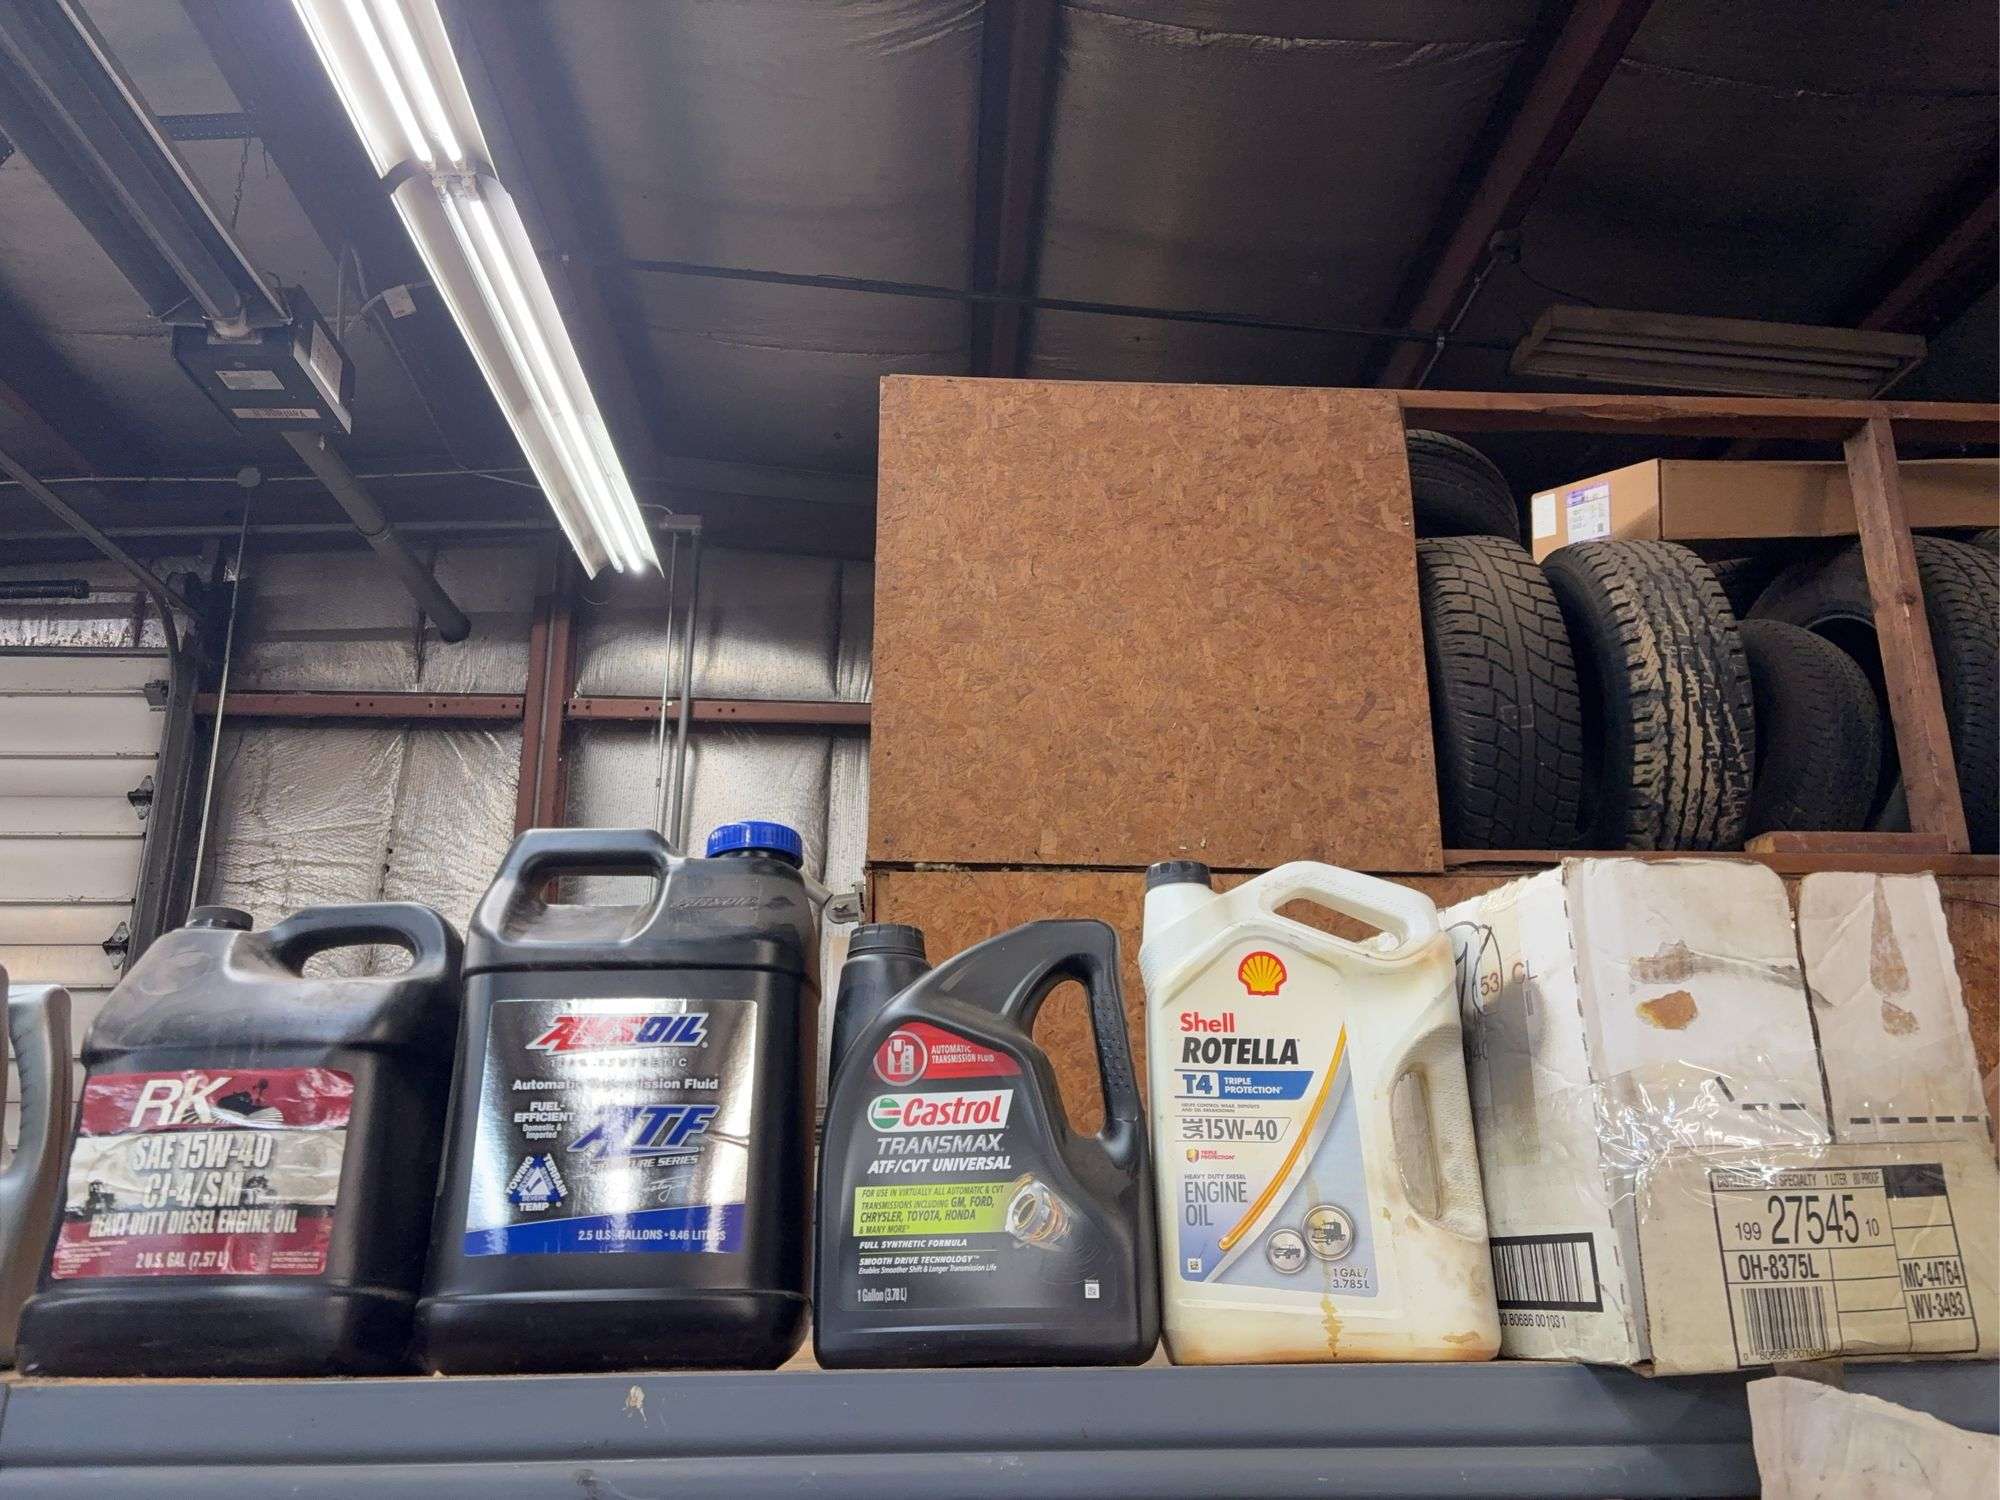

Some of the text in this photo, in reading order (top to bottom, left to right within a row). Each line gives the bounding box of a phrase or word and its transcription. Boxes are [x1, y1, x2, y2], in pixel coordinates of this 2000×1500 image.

[1180, 1012, 1235, 1032] Shell
[931, 1044, 972, 1054] AUTOMATIC
[1182, 1037, 1299, 1065] ROTELLA
[932, 1053, 995, 1064] TRANSMISSION FLUID
[685, 1078, 719, 1090] Fluid
[1182, 1074, 1213, 1094] T4
[1224, 1077, 1252, 1085] TRIPLE
[530, 1101, 566, 1112] FUEL-
[903, 1095, 1002, 1127] Castrol
[514, 1112, 576, 1123] EFFICIENT
[567, 1104, 720, 1159] ATF
[1182, 1118, 1278, 1140] SAE 15W-40
[132, 1133, 274, 1171] SAE 15W-40
[877, 1134, 1004, 1155] TRANSMAX
[657, 1155, 699, 1167] SERIES
[867, 1156, 1012, 1174] ATF/CVT UNIVERSAL
[505, 1155, 535, 1194] TOWING
[543, 1152, 568, 1197] TERRAIN
[1779, 1173, 1817, 1187] SPECIALTY
[142, 1171, 245, 1208] CJ-4/SM
[862, 1190, 875, 1198] FOR
[876, 1189, 889, 1197] USE
[890, 1188, 898, 1196] IN
[899, 1187, 932, 1196] VIRTUALLY
[933, 1187, 945, 1195] ALL
[946, 1186, 983, 1195] AUTOMATIC
[991, 1185, 1004, 1194] CVT
[1184, 1181, 1248, 1203] ENGINE
[519, 1202, 550, 1211] TEMP
[861, 1200, 912, 1210] TRANSMISSIONS
[970, 1196, 994, 1208] FORD,
[166, 1209, 215, 1235] DIESEL
[217, 1209, 273, 1234] ENGINE
[273, 1209, 298, 1233] OIL
[860, 1209, 976, 1223] CHRYSLER, TOYOTA, HONDA
[1186, 1204, 1214, 1226] OIL
[1735, 1193, 1880, 1244] 199 27545 10
[578, 1230, 593, 1240] 2.5
[618, 1229, 663, 1240] GALLONS
[669, 1229, 689, 1240] 9.46
[866, 1226, 885, 1234] MANY
[859, 1239, 968, 1249] FULL SYNTHETIC FORMULA
[135, 1252, 145, 1269] 2
[188, 1251, 217, 1271] (7.57
[858, 1267, 881, 1275] Enables
[881, 1266, 909, 1274] Smoother
[909, 1265, 923, 1273] Shift
[929, 1265, 949, 1275] Longer
[950, 1264, 986, 1273] Transmission
[986, 1263, 997, 1272] Life
[859, 1257, 893, 1266] SMOOTH
[894, 1256, 919, 1264] DRIVE
[1738, 1253, 1820, 1280] OH-8375L
[1903, 1260, 1962, 1288] MC-44764
[857, 1289, 862, 1302] 1
[862, 1288, 884, 1302] Gallon
[1911, 1291, 1966, 1319] WV-3493
[1509, 1313, 1534, 1327] 80686
[1535, 1313, 1561, 1328] 00103
